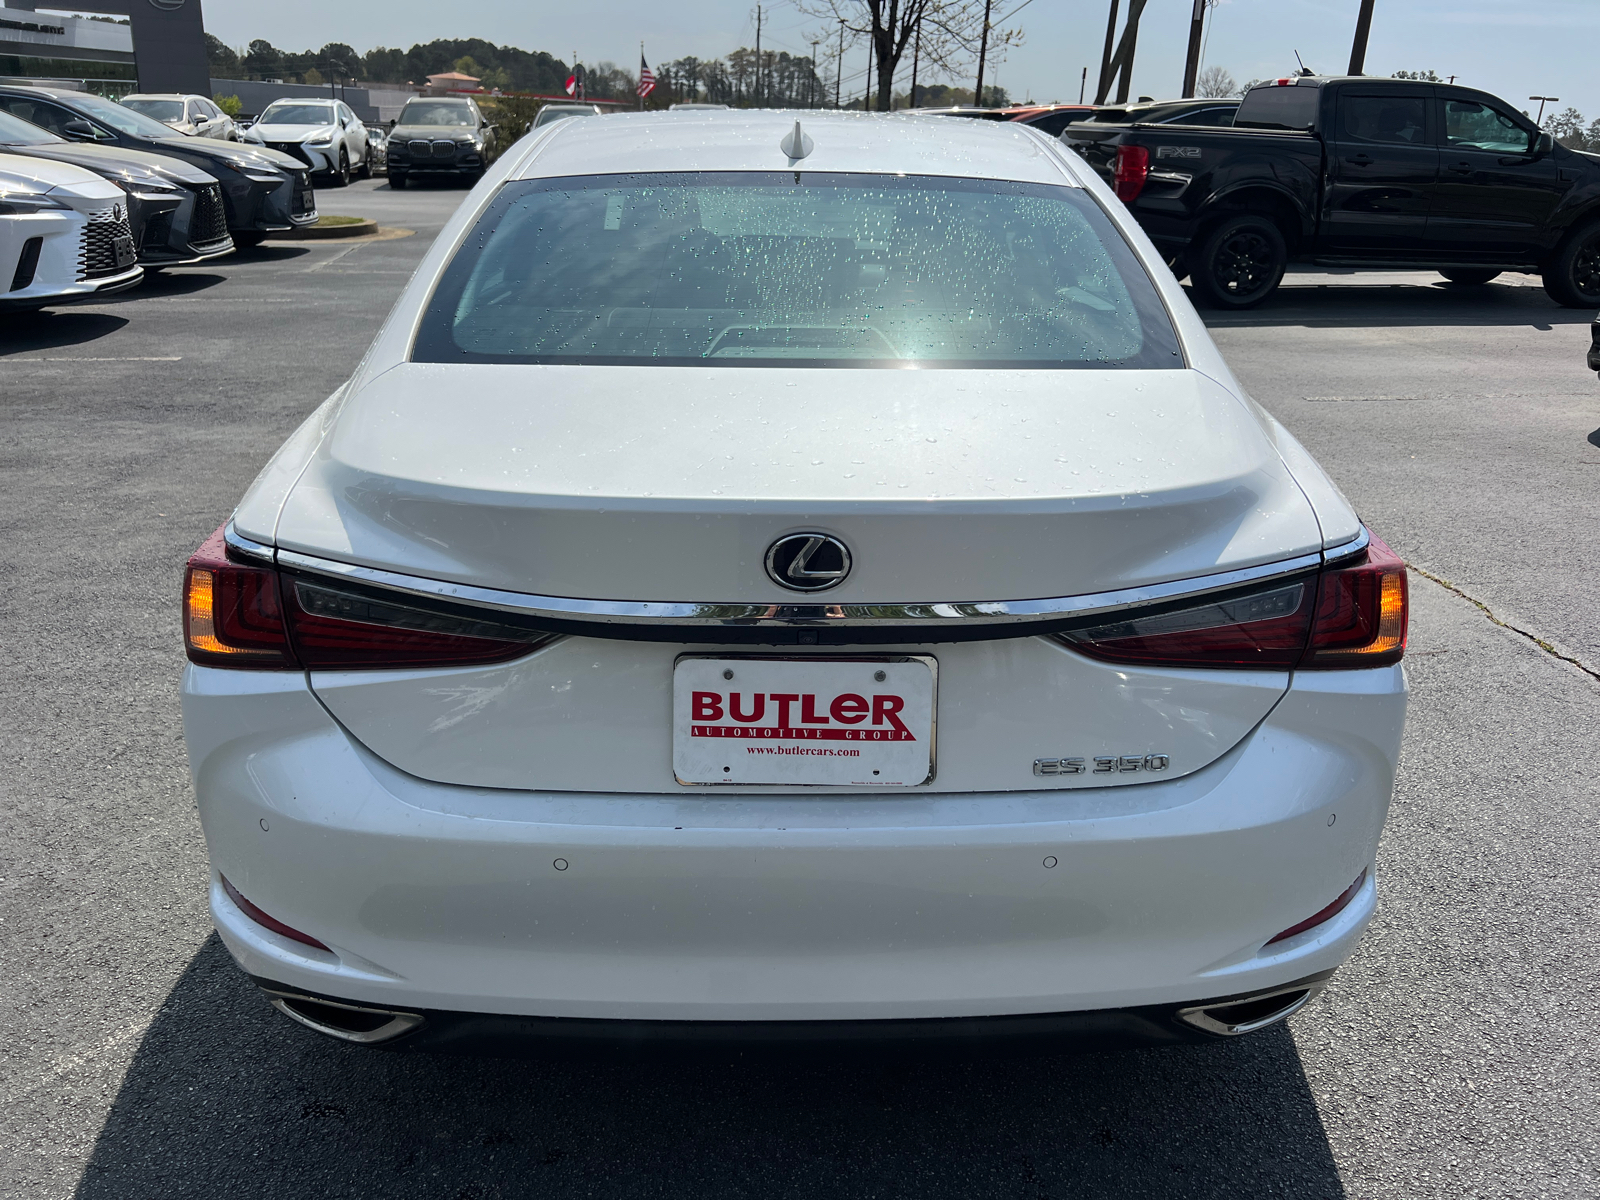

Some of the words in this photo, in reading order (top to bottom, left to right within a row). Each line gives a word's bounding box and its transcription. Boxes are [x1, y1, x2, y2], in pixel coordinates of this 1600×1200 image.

[1156, 146, 1202, 159] FX2
[692, 727, 823, 739] AUTOMOTIVE
[845, 730, 909, 740] GROUP
[746, 745, 860, 757] www.butlercars.com
[1033, 758, 1086, 776] ES
[1093, 753, 1170, 775] 350
